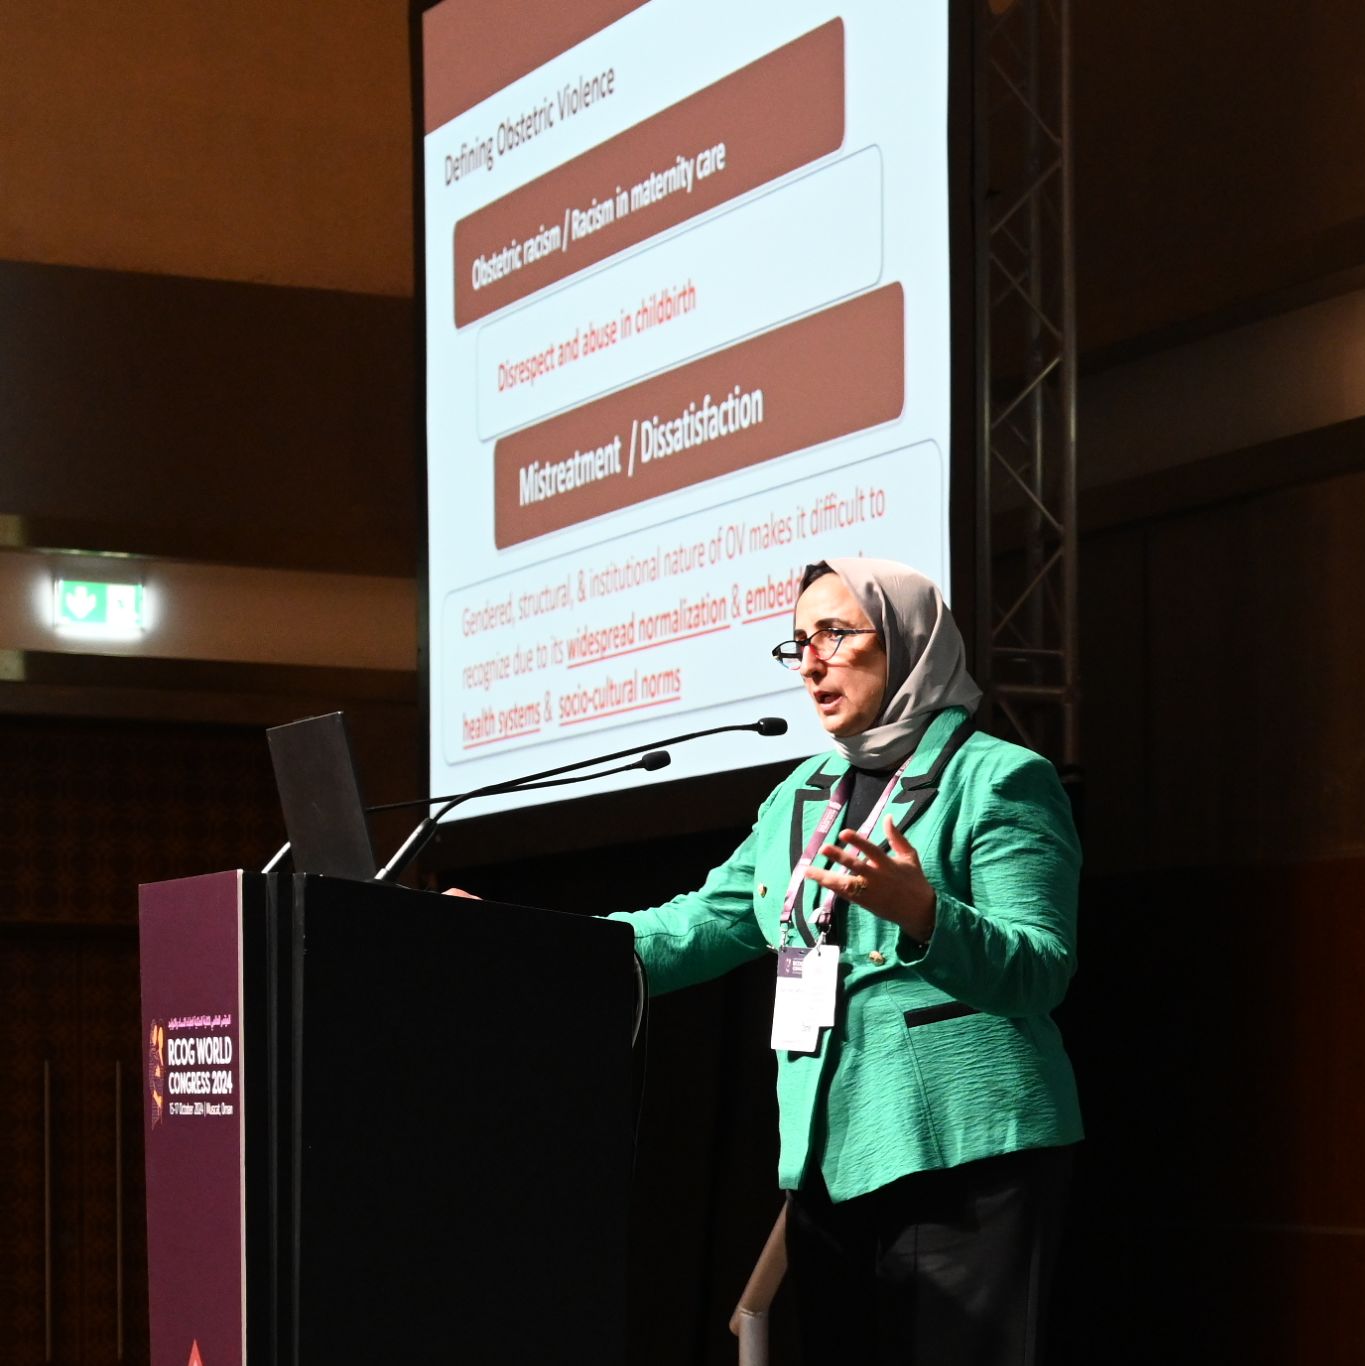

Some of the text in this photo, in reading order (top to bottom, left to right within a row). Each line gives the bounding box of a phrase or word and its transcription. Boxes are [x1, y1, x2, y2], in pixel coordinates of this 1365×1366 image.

[445, 67, 615, 186] Defining Obstetric Violence
[471, 142, 726, 290] Obstetric racism / Racism in maternity care
[498, 278, 696, 392] Disrespect and abuse in childbirth
[519, 385, 763, 506] Mistreatment / Dissatisfaction
[462, 487, 885, 637] Gendered, structural, & institutional nature of OV makes it difficult to
[462, 652, 510, 691] recognize
[513, 643, 533, 676] due
[537, 642, 547, 669] to
[551, 635, 564, 665] its
[567, 611, 635, 660] widespread
[731, 583, 740, 618] &
[462, 668, 681, 741] health systems & socio-cultural norms
[168, 1036, 232, 1066] RCOG WORLD
[168, 1070, 233, 1094] CONGRESS 2024
